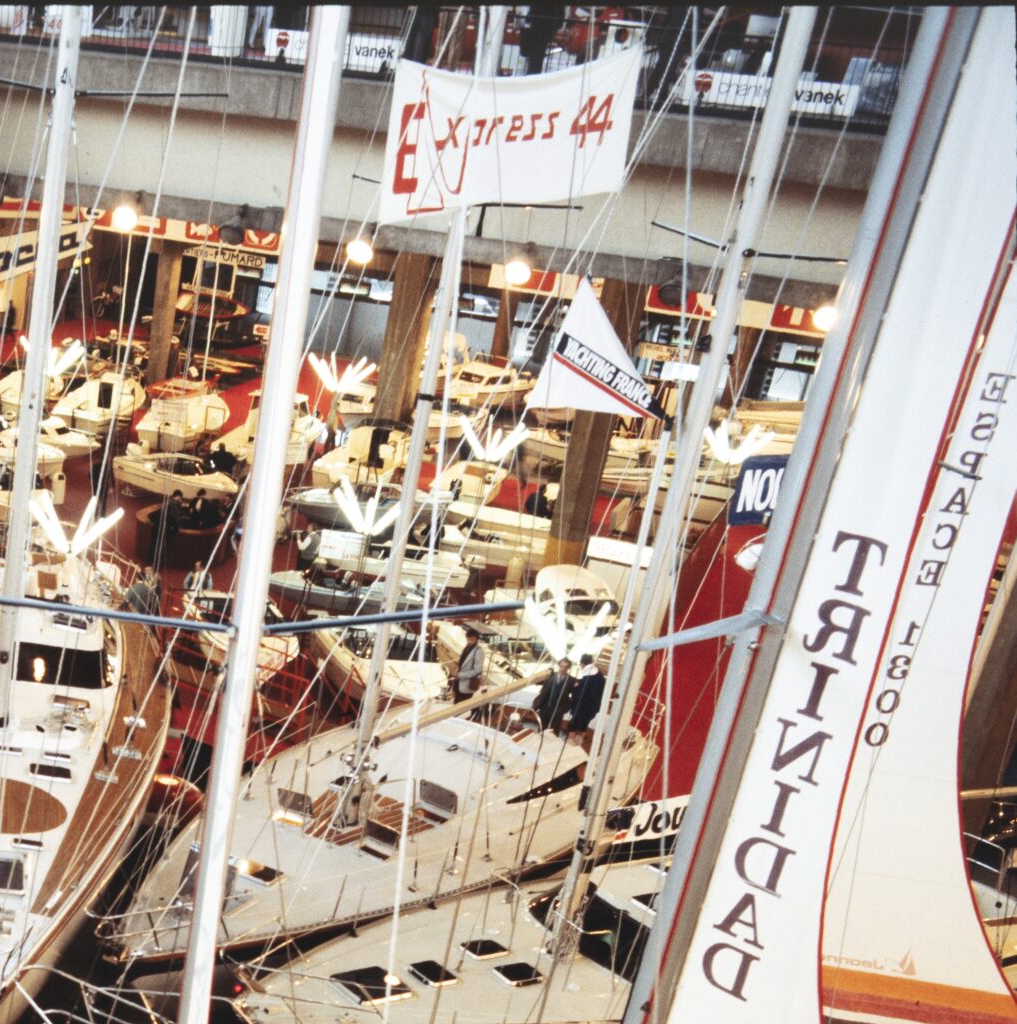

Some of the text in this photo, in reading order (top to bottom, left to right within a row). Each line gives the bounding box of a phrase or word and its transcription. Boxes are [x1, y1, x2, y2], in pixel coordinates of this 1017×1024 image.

[355, 45, 395, 59] vanek
[794, 89, 846, 106] vanek
[569, 93, 614, 149] 44
[563, 337, 616, 385] YACHTING
